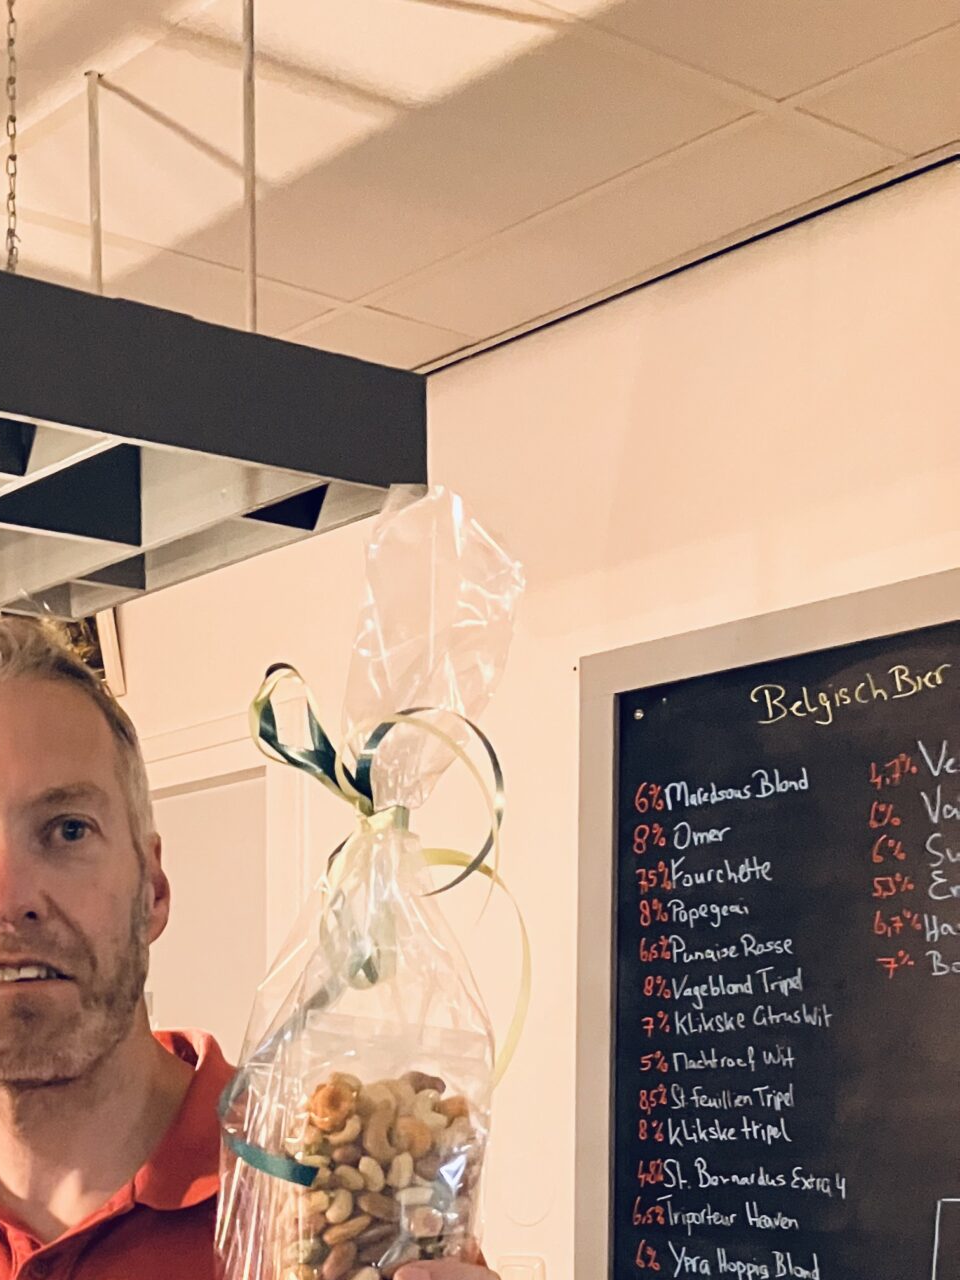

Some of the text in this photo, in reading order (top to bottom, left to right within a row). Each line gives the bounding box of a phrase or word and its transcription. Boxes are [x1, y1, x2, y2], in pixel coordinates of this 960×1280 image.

[751, 664, 952, 725] Belgisch Bier
[634, 767, 809, 813] 6% Maredsous Blond
[633, 821, 731, 854] 8% Omer
[872, 834, 906, 863] 6%
[671, 856, 773, 889] Fourchette
[640, 899, 668, 926] 8%
[876, 950, 915, 979] 7%
[643, 975, 671, 999] 8%
[641, 1010, 671, 1037] 7%
[640, 1050, 669, 1073] 5%
[638, 1119, 664, 1142] 8%
[635, 1239, 661, 1271] 6%
